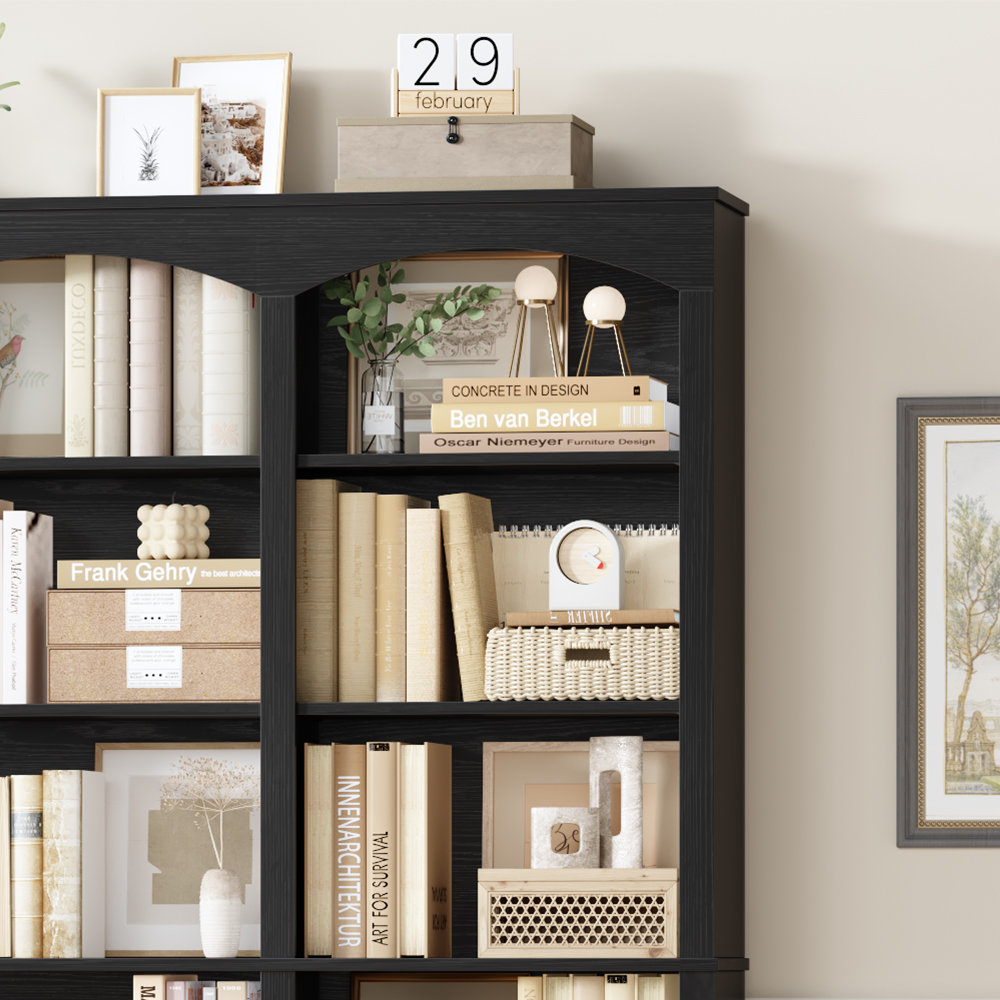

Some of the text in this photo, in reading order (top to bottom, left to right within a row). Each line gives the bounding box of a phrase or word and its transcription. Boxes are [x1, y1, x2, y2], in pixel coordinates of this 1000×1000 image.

[415, 92, 493, 114] february
[451, 383, 589, 398] CONCRETE IN DESIGN
[450, 408, 597, 428] Ben van Berkel
[434, 437, 482, 447] Oscar
[487, 436, 564, 448] Niemeyer
[618, 437, 656, 446] Design
[71, 562, 197, 585] Frank Gehry
[337, 776, 361, 947] INNENARCHITEKTUR
[372, 831, 388, 946] ART FOR SURVIVAL
